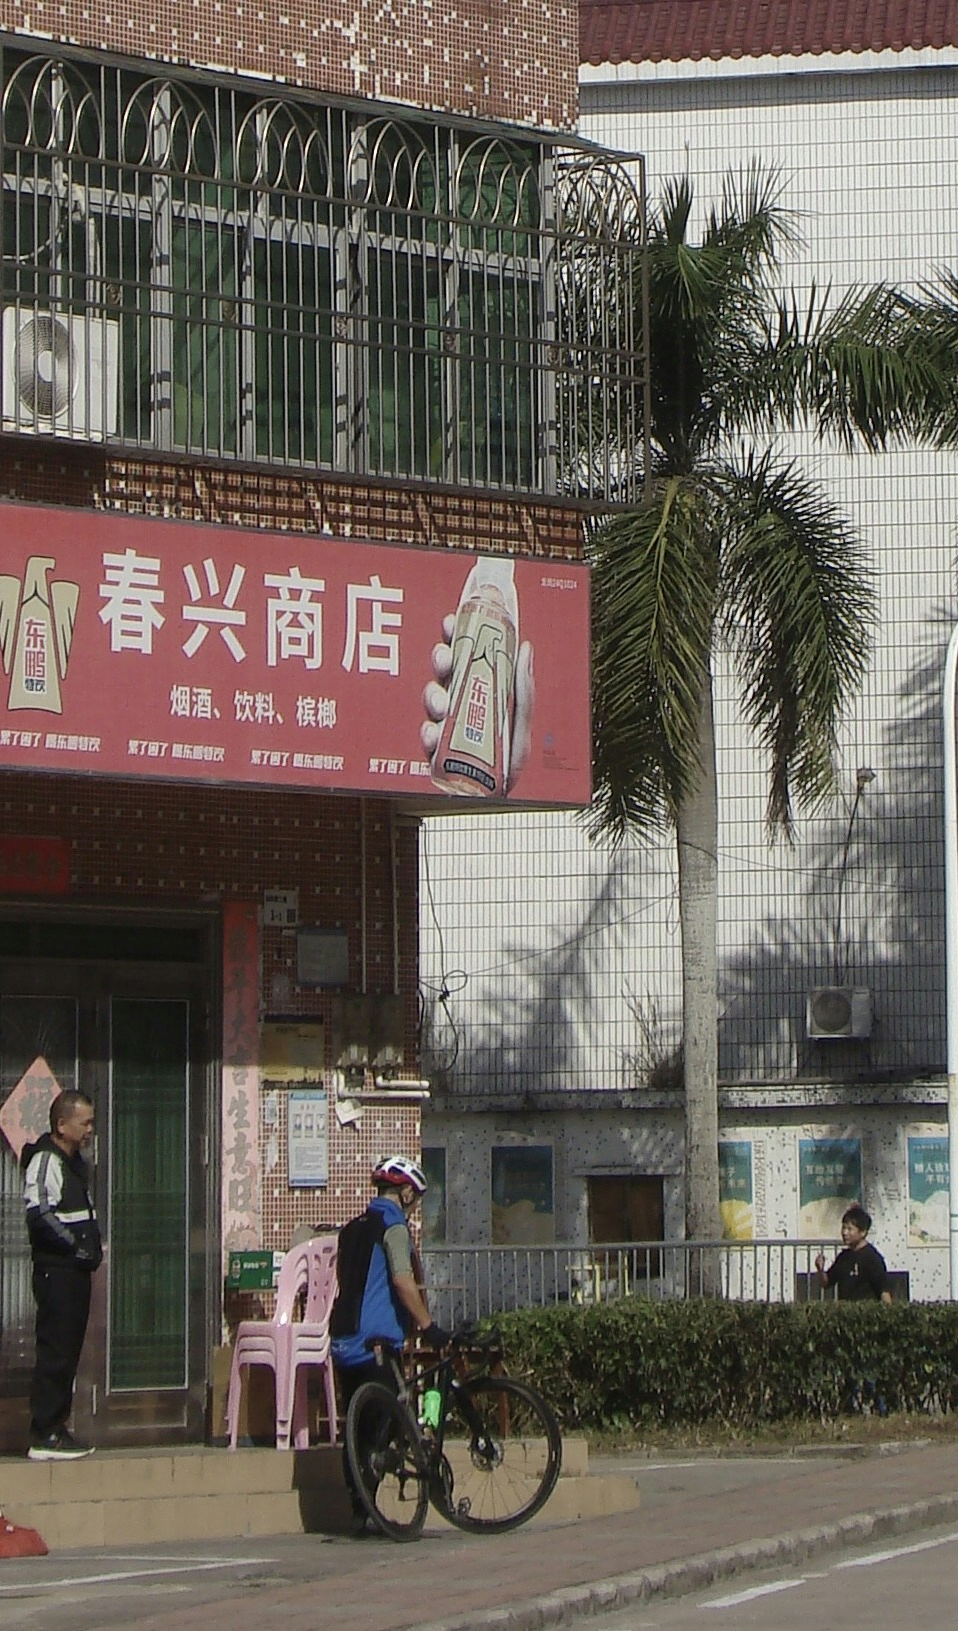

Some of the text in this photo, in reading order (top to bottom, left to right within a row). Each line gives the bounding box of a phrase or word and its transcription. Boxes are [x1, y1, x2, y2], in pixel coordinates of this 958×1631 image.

[98, 548, 404, 676] 春兴商店
[25, 619, 45, 679] 东鹏
[25, 679, 46, 693] 特饮
[467, 676, 489, 731] 东鹏
